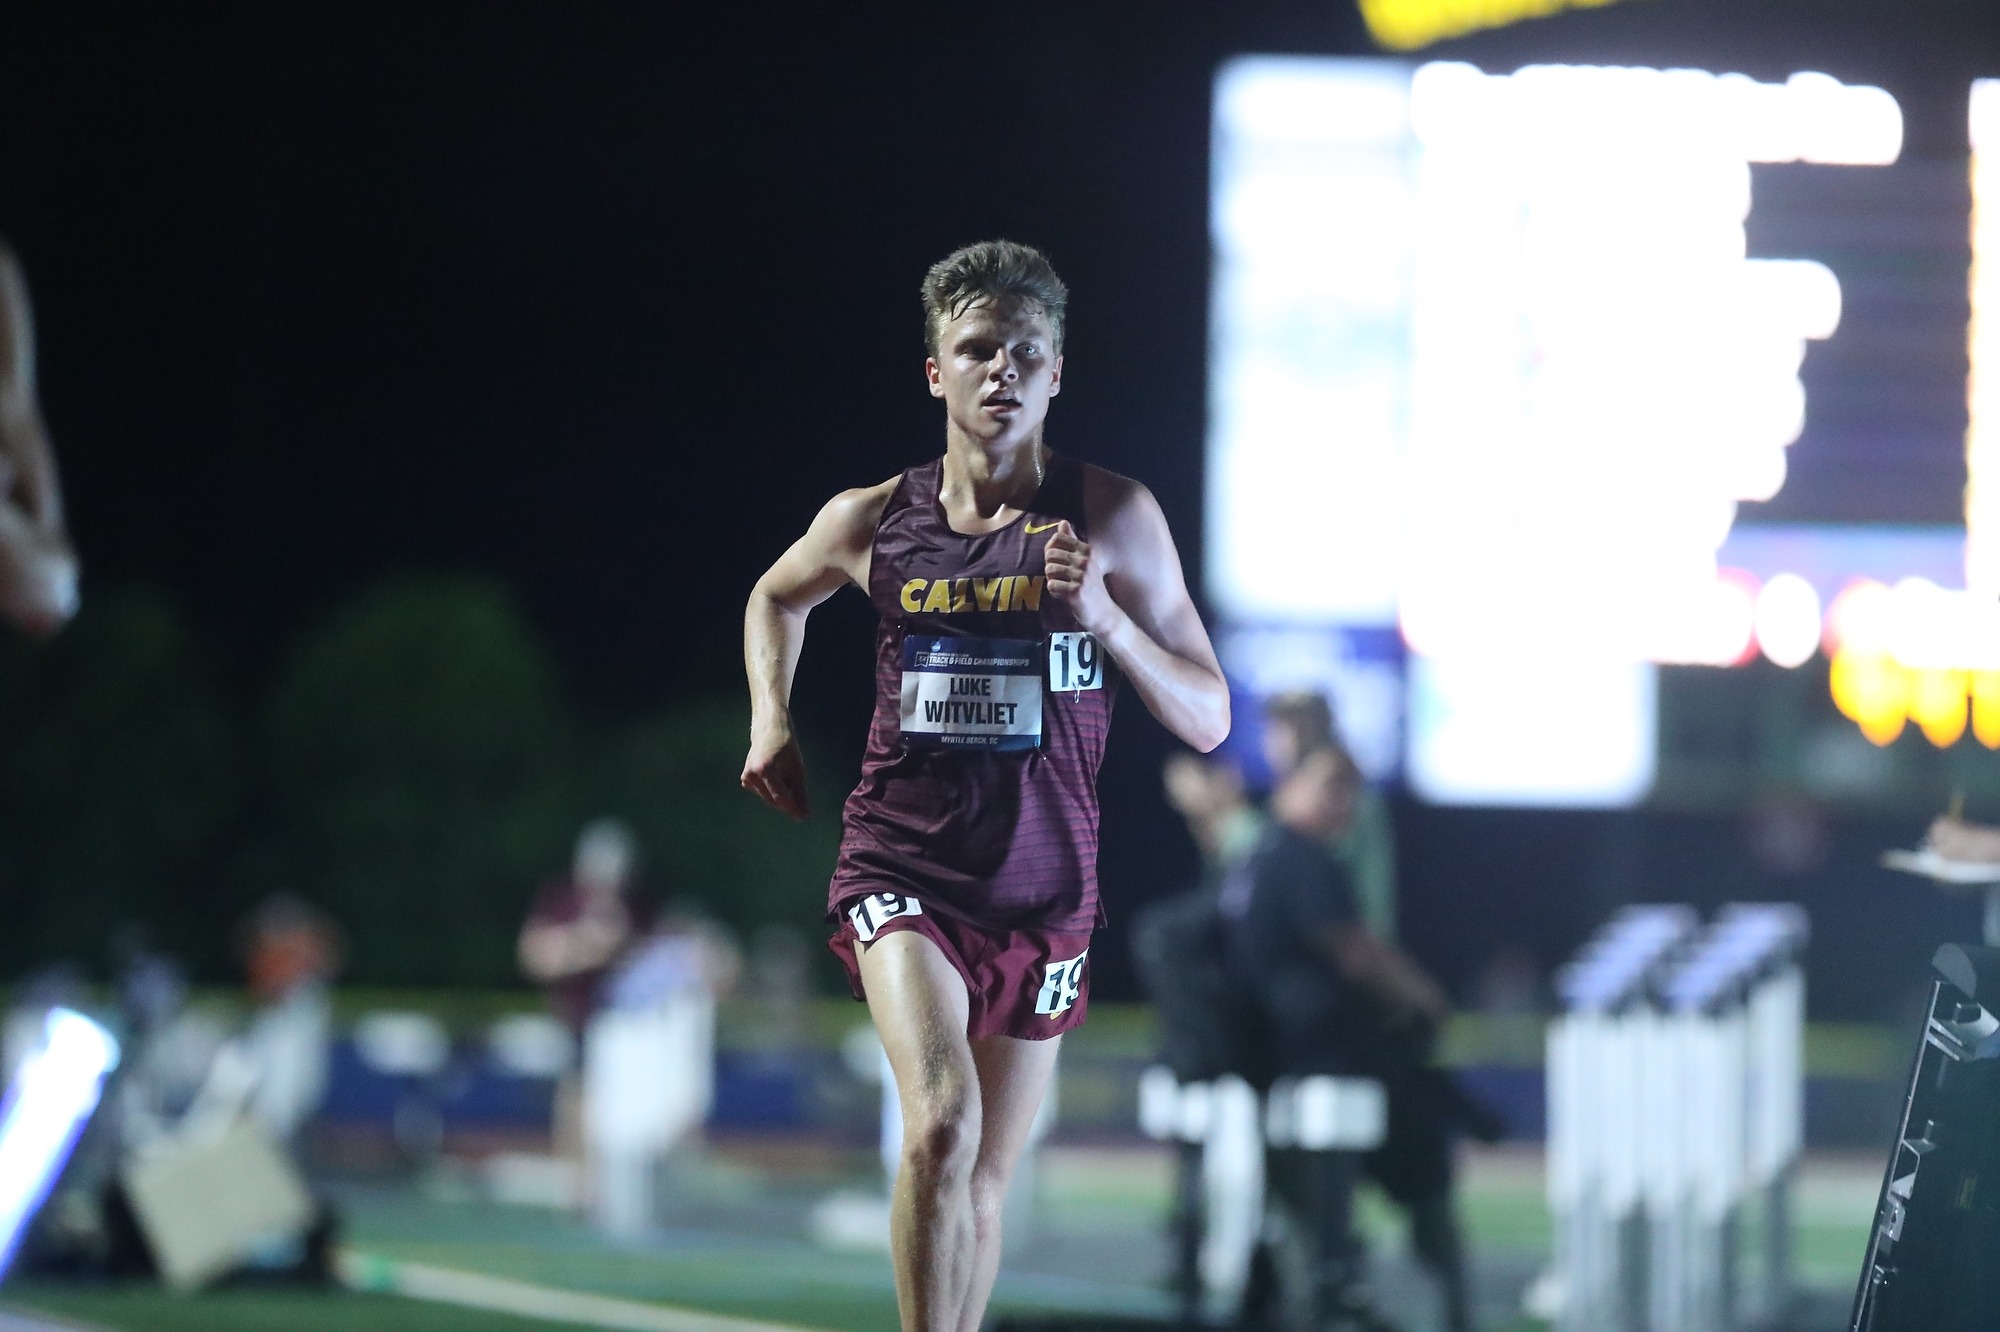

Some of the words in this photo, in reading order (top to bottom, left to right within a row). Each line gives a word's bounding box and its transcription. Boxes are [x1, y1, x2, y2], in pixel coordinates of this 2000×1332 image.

[901, 576, 1044, 613] CALVIN
[929, 656, 949, 664] TRACK
[954, 657, 973, 666] FIELD
[973, 658, 1030, 667] CHAMPIONSHIPS
[1054, 634, 1097, 688] 19
[950, 677, 991, 696] LUKE
[924, 700, 1018, 725] WITVLIET
[941, 736, 965, 744] MYRTLE
[856, 893, 908, 935] 19
